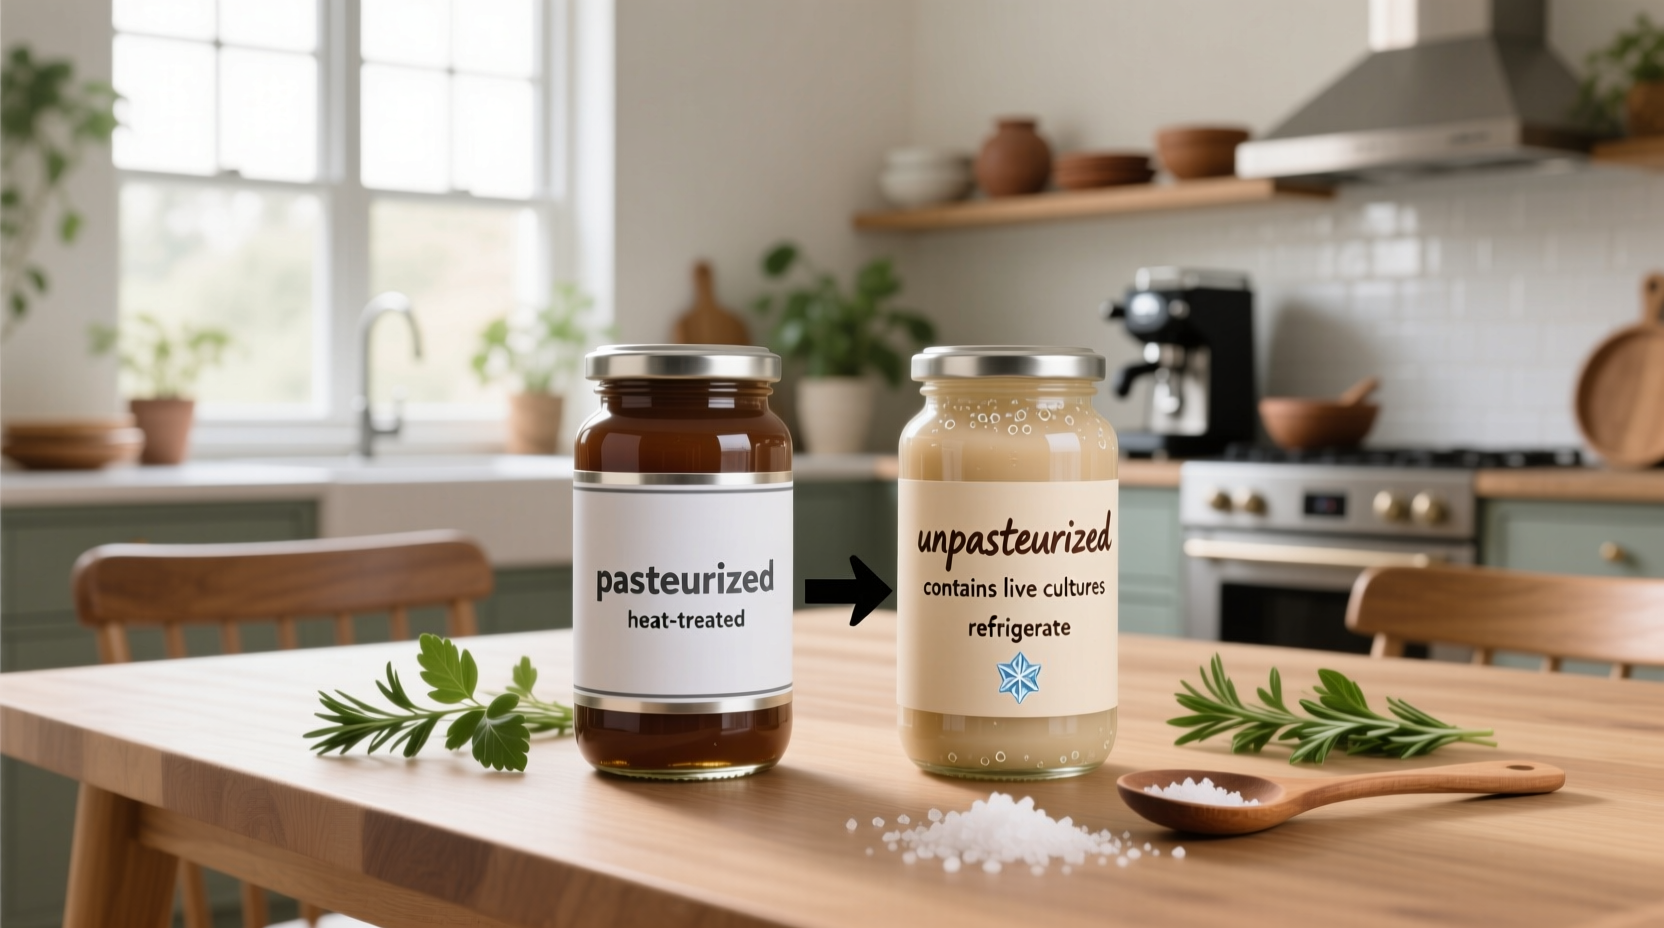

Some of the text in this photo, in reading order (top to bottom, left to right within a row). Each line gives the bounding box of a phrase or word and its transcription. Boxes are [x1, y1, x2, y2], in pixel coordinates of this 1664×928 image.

[917, 510, 1112, 572] unpasteurized
[596, 558, 774, 602] pasteurized
[923, 575, 1106, 598] contains live cultures
[627, 609, 745, 630] heat-treated
[968, 615, 1071, 644] refrigerate
